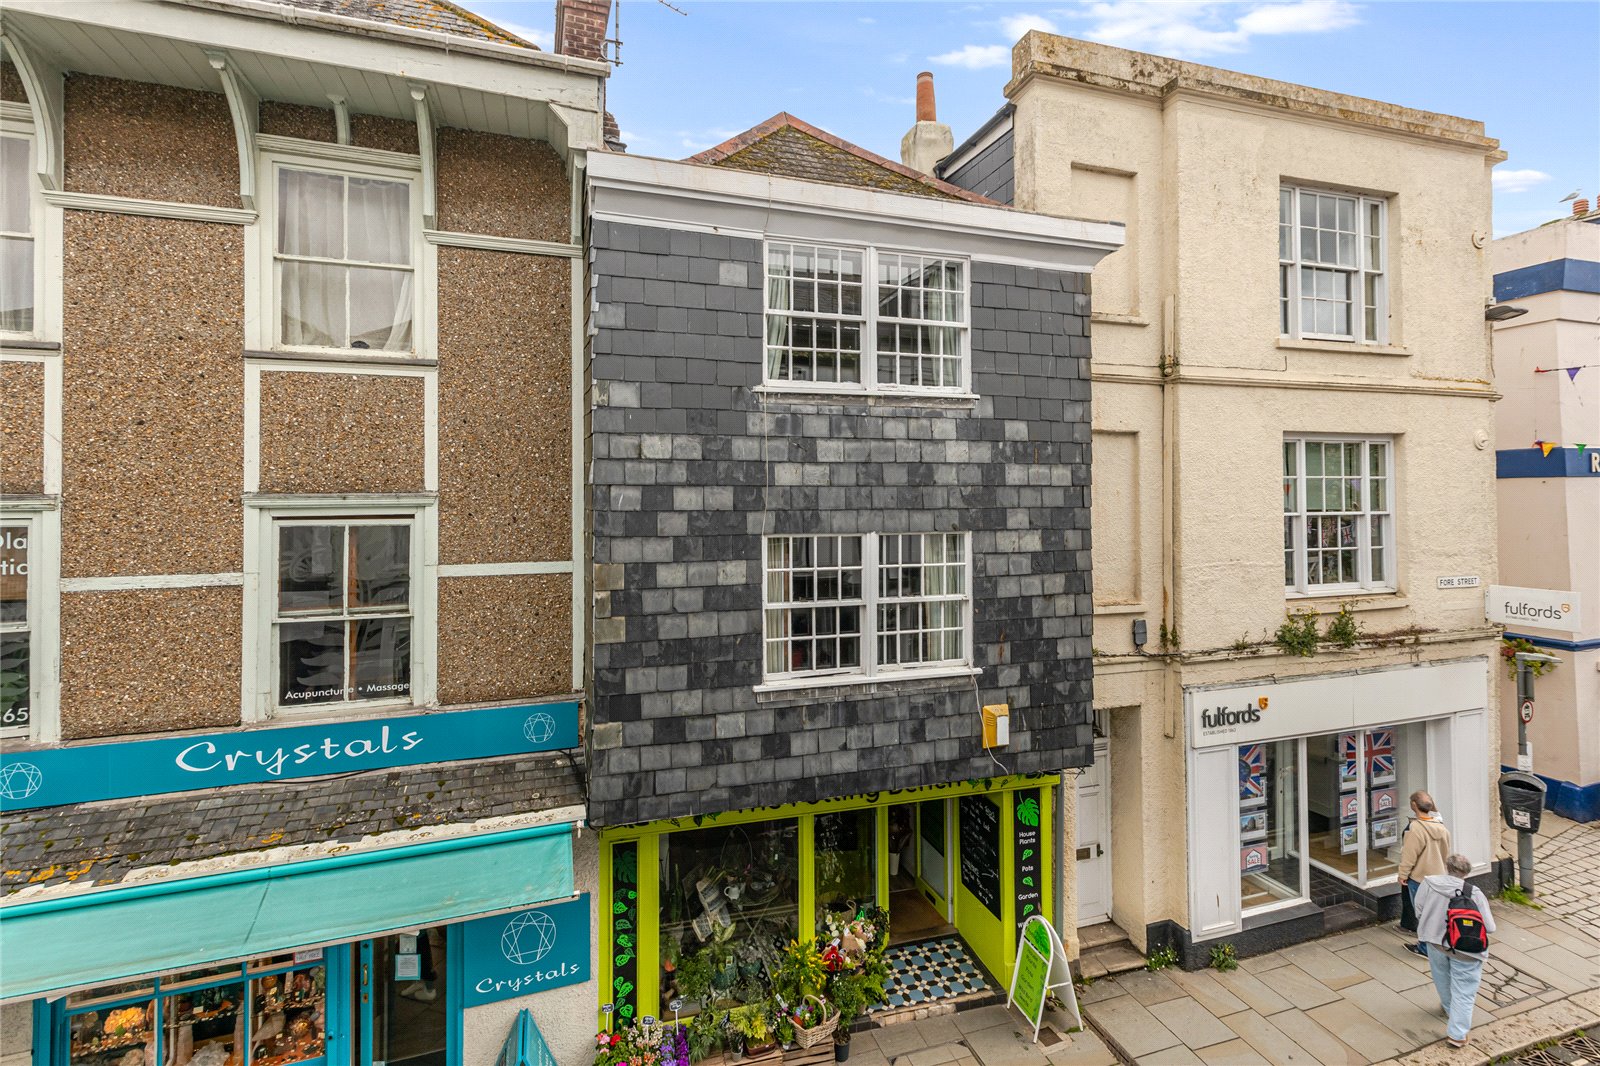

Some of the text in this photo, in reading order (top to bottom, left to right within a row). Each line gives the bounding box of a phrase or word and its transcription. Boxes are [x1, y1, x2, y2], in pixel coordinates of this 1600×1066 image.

[1457, 577, 1477, 585] STREET
[1504, 601, 1562, 619] fulfords
[285, 682, 409, 700] Acupuncture Massage
[1201, 703, 1261, 728] fulfords
[175, 725, 424, 775] Crystals
[1019, 837, 1036, 845] Plants
[1017, 892, 1039, 901] Garden
[475, 962, 580, 993] Crystals
